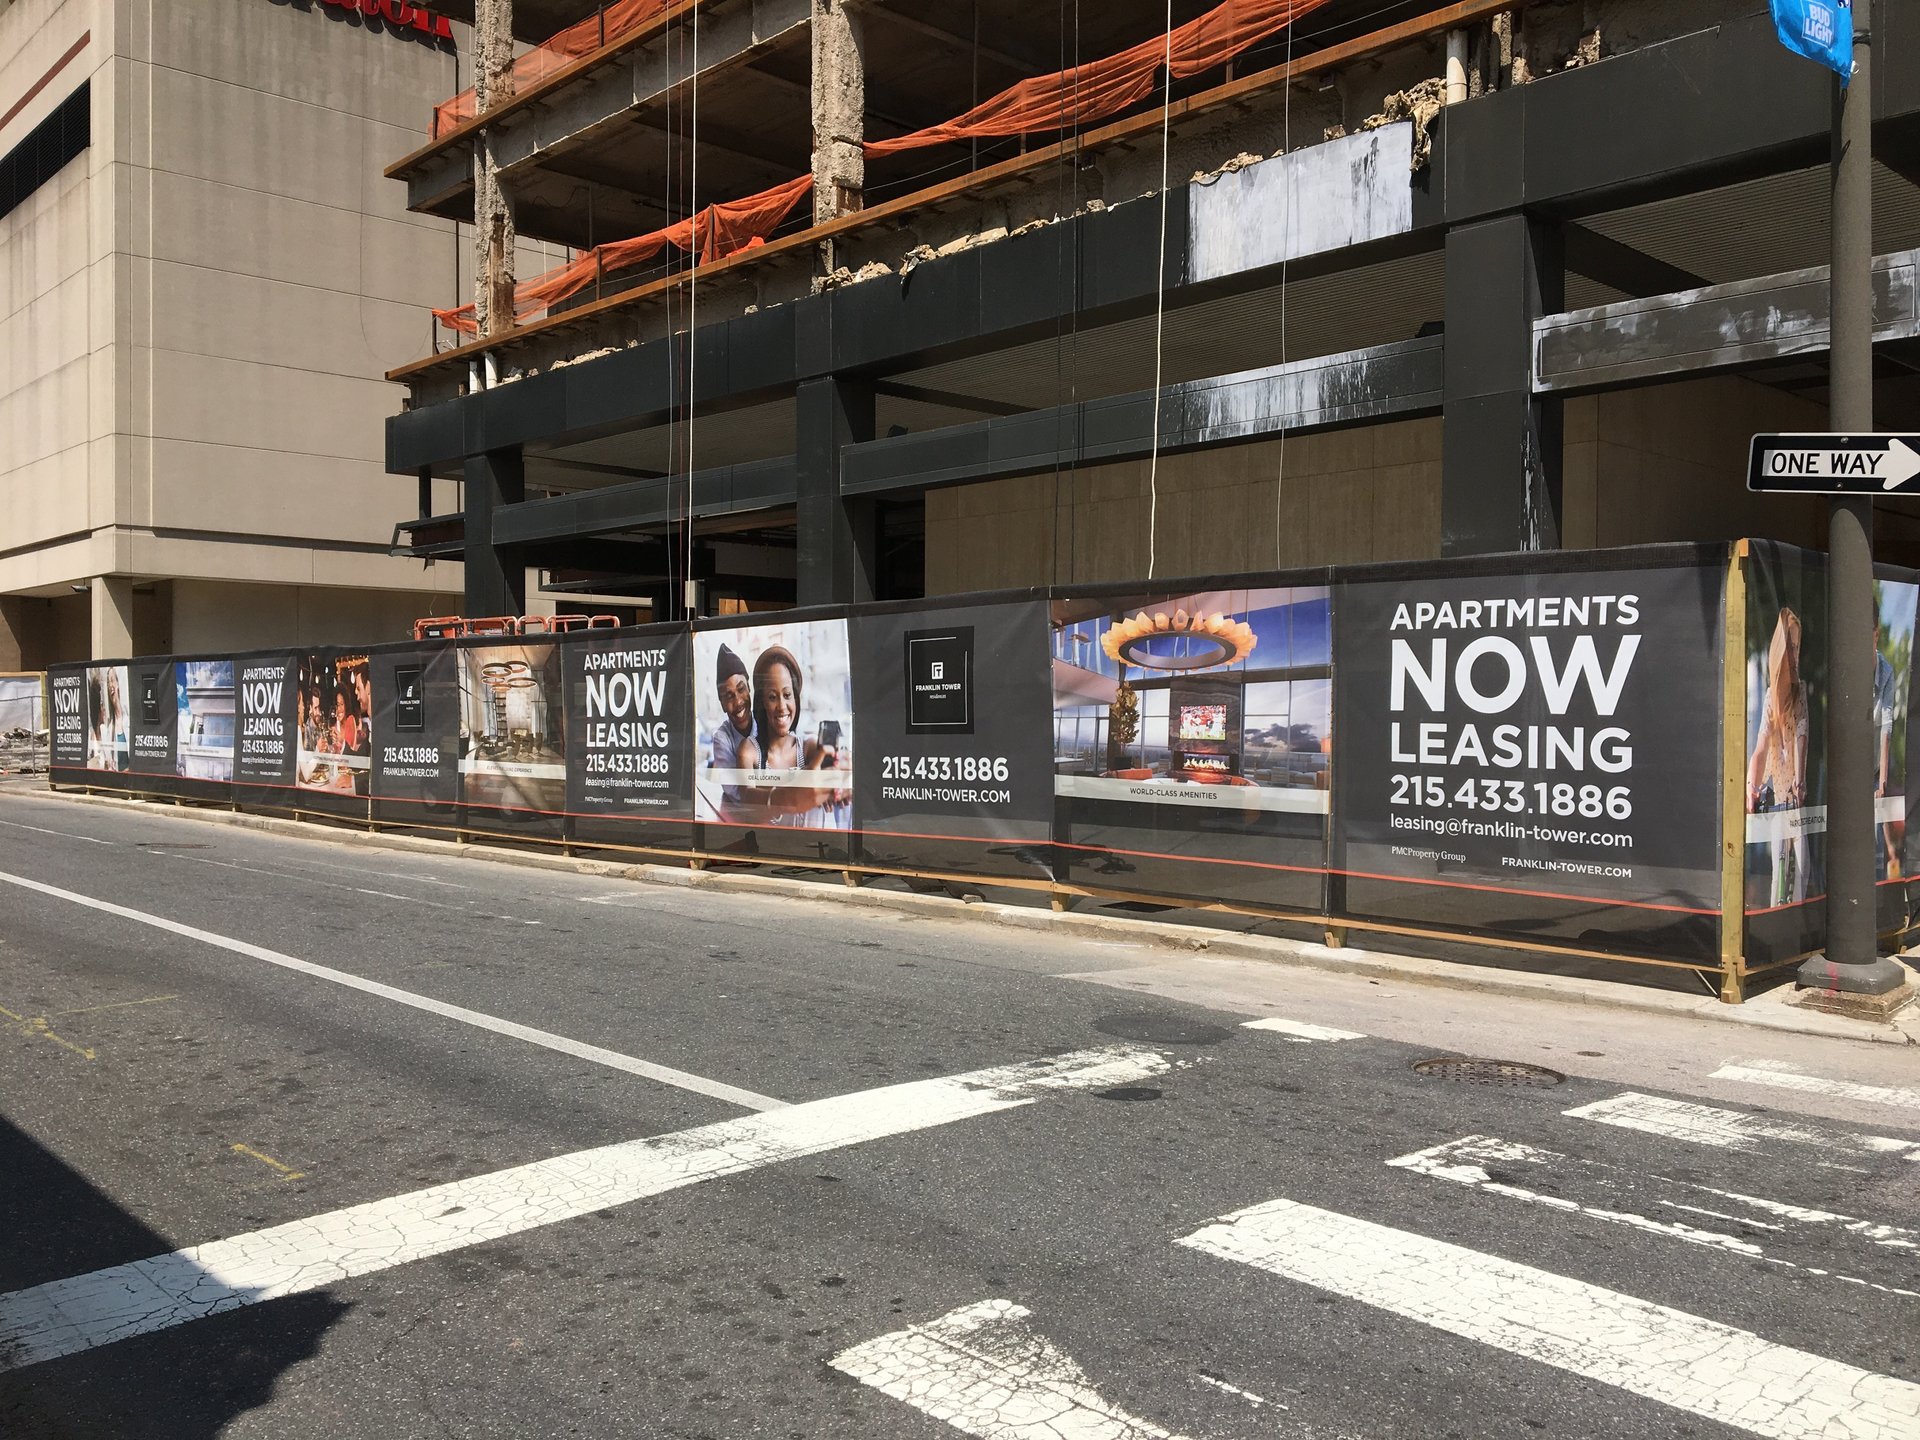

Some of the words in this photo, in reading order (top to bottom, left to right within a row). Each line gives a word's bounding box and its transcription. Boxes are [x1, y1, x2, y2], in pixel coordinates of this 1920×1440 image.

[1809, 4, 1831, 26] BUD
[1805, 18, 1834, 44] LIGHT
[1771, 452, 1820, 474] ONE
[1831, 453, 1884, 475] WAY
[1390, 595, 1640, 630] APARTMENTS
[584, 649, 666, 670] APARTMENTS
[54, 677, 80, 687] APARTMENTS
[242, 667, 285, 680] APARTMENTS
[1390, 634, 1642, 716] NOW
[54, 688, 80, 713] NOW
[242, 682, 283, 714] NOW
[585, 671, 667, 717] NOW
[56, 716, 81, 730] LEASING
[243, 718, 284, 736] LEASING
[586, 722, 669, 748] LEASING
[242, 740, 284, 754] 215.433.1886
[383, 747, 439, 764] 215.433.1886
[1390, 722, 1633, 773] LEASING
[383, 767, 439, 777] FRANKLIN-TOWER.COM
[586, 753, 669, 774] 215.433.1886
[882, 756, 1009, 782] 215.433.1886
[585, 777, 669, 789] leasing@franklin-tower.com
[1129, 787, 1178, 798] WORLD-CLASS
[1179, 790, 1217, 800] AMENITIES
[882, 786, 1010, 803] FRANKLIN-TOWER.COM
[1390, 775, 1633, 820] 215.433.1886
[1391, 813, 1633, 848] leasing@franklin-tower.com
[1440, 850, 1467, 864] Group
[1501, 857, 1633, 879] FRANKLIN-TOWER.COM
